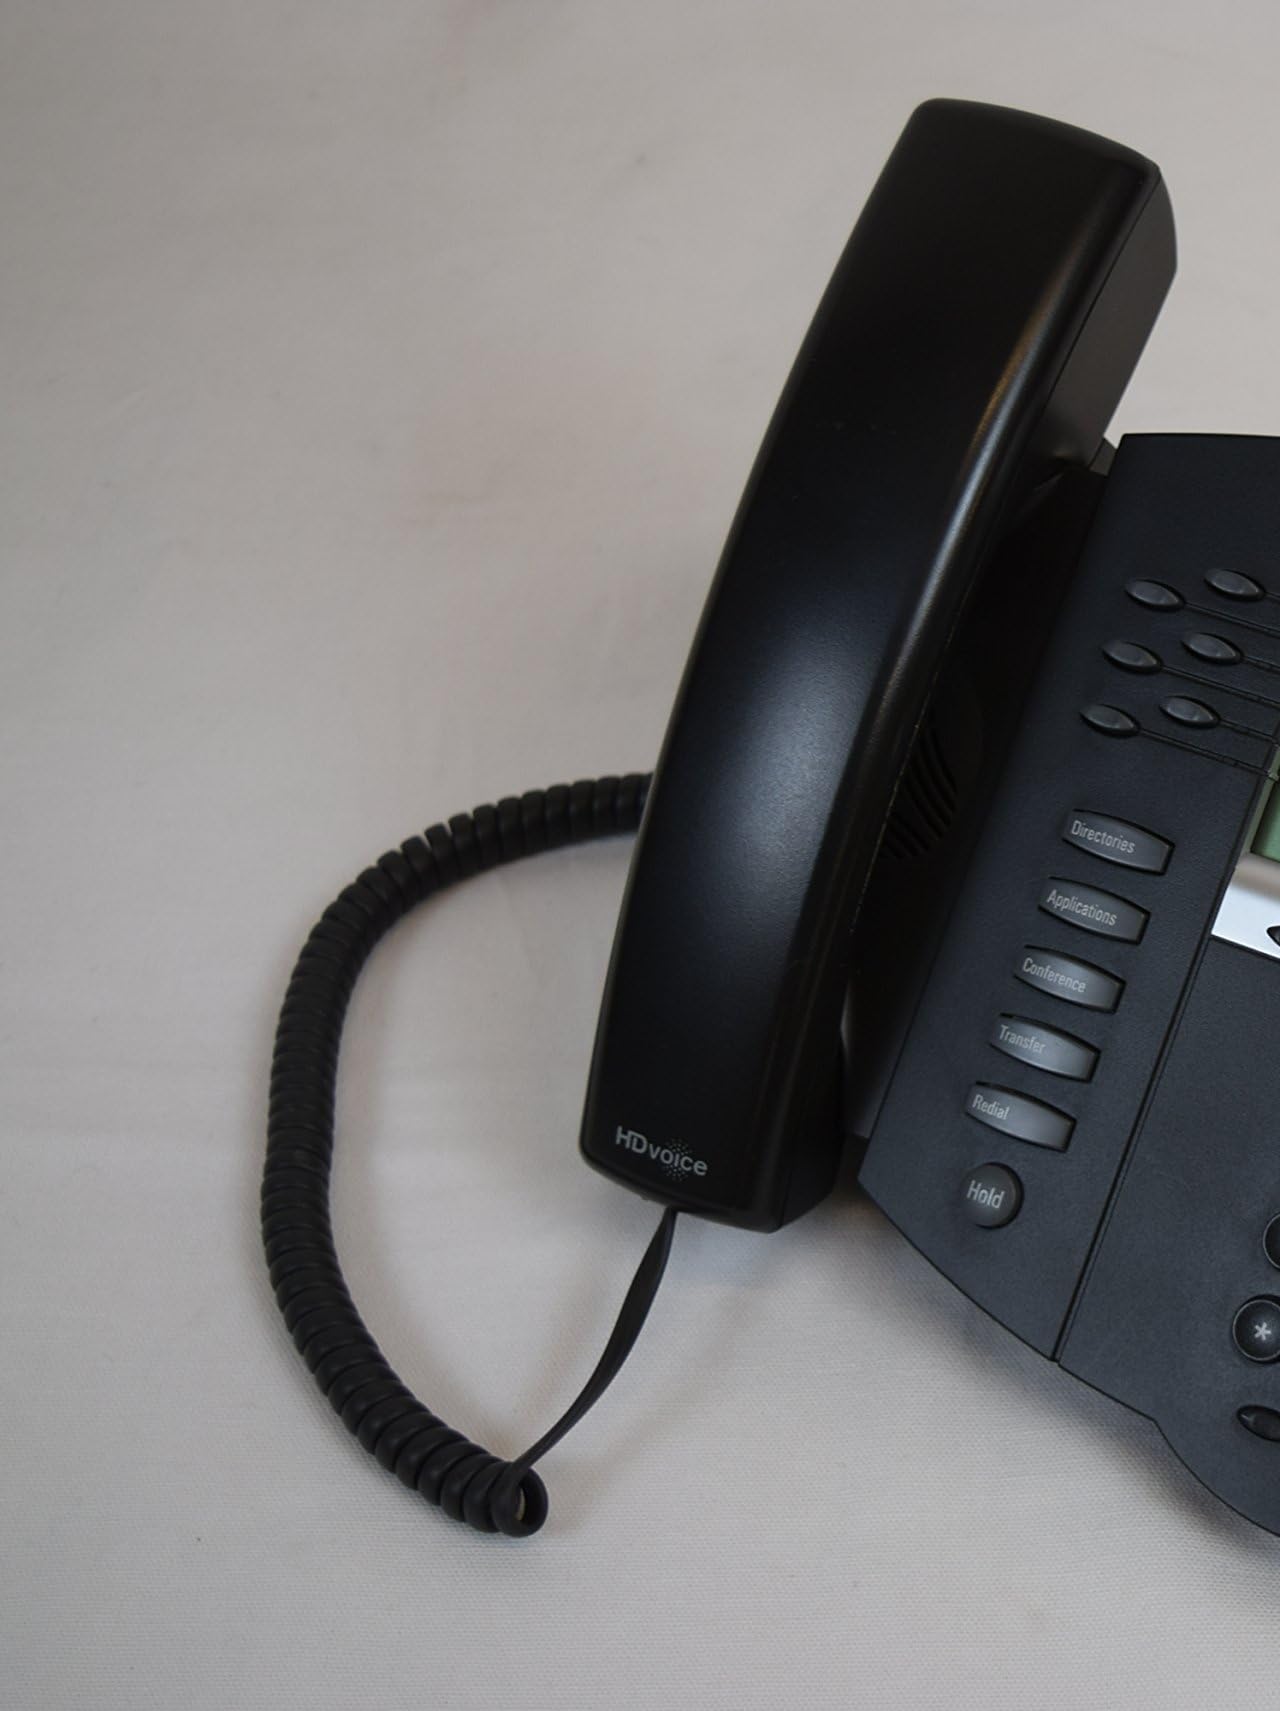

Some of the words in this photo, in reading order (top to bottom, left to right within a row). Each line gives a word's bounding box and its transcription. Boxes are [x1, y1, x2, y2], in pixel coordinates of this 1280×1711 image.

[1071, 820, 1135, 854] Directories
[1047, 888, 1117, 926] Applications
[1023, 957, 1086, 993] Conference
[1000, 1025, 1046, 1054] Transfer
[972, 1094, 1009, 1121] Redial
[967, 1180, 1004, 1209] Hold
